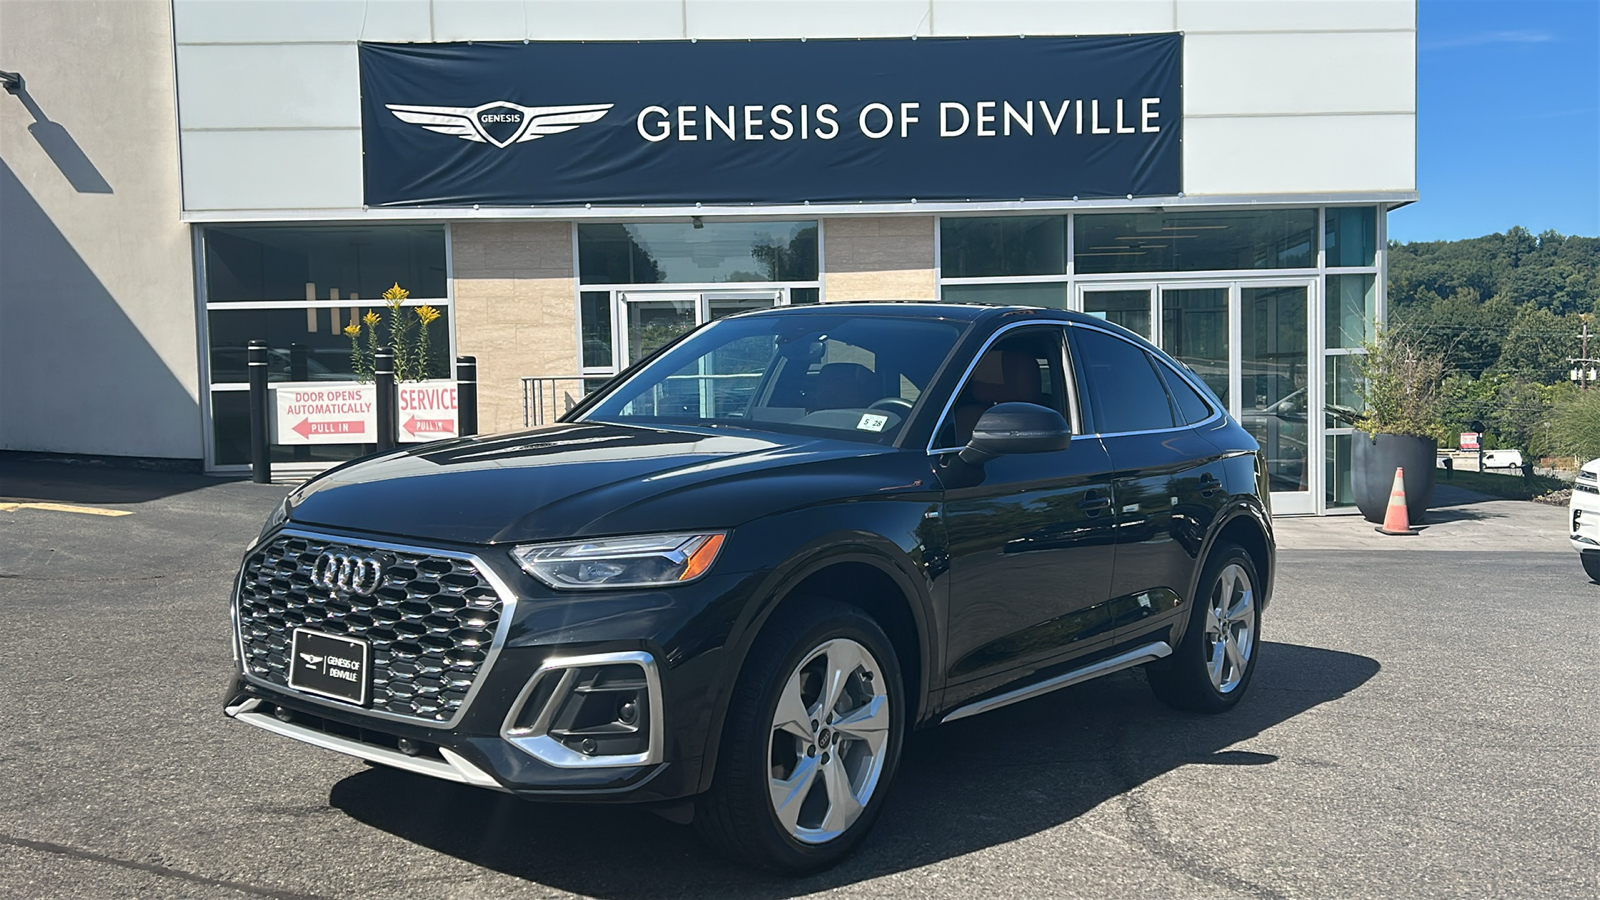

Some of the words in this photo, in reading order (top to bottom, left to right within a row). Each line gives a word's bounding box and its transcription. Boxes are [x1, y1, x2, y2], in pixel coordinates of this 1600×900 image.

[481, 114, 521, 123] GENESIS
[636, 103, 840, 142] GENESIS
[858, 101, 920, 139] OF
[939, 97, 1161, 138] DENVILLE
[295, 392, 325, 402] DOOR
[327, 390, 362, 401] OPENS
[400, 388, 458, 410] SERVICE
[287, 402, 372, 415] AUTOMATICALLY
[311, 423, 335, 433] PULL
[338, 422, 349, 432] IN
[416, 422, 433, 431] PULL
[327, 656, 351, 668] GENESIS
[351, 661, 360, 670] OF
[329, 667, 358, 682] DENVILLE
